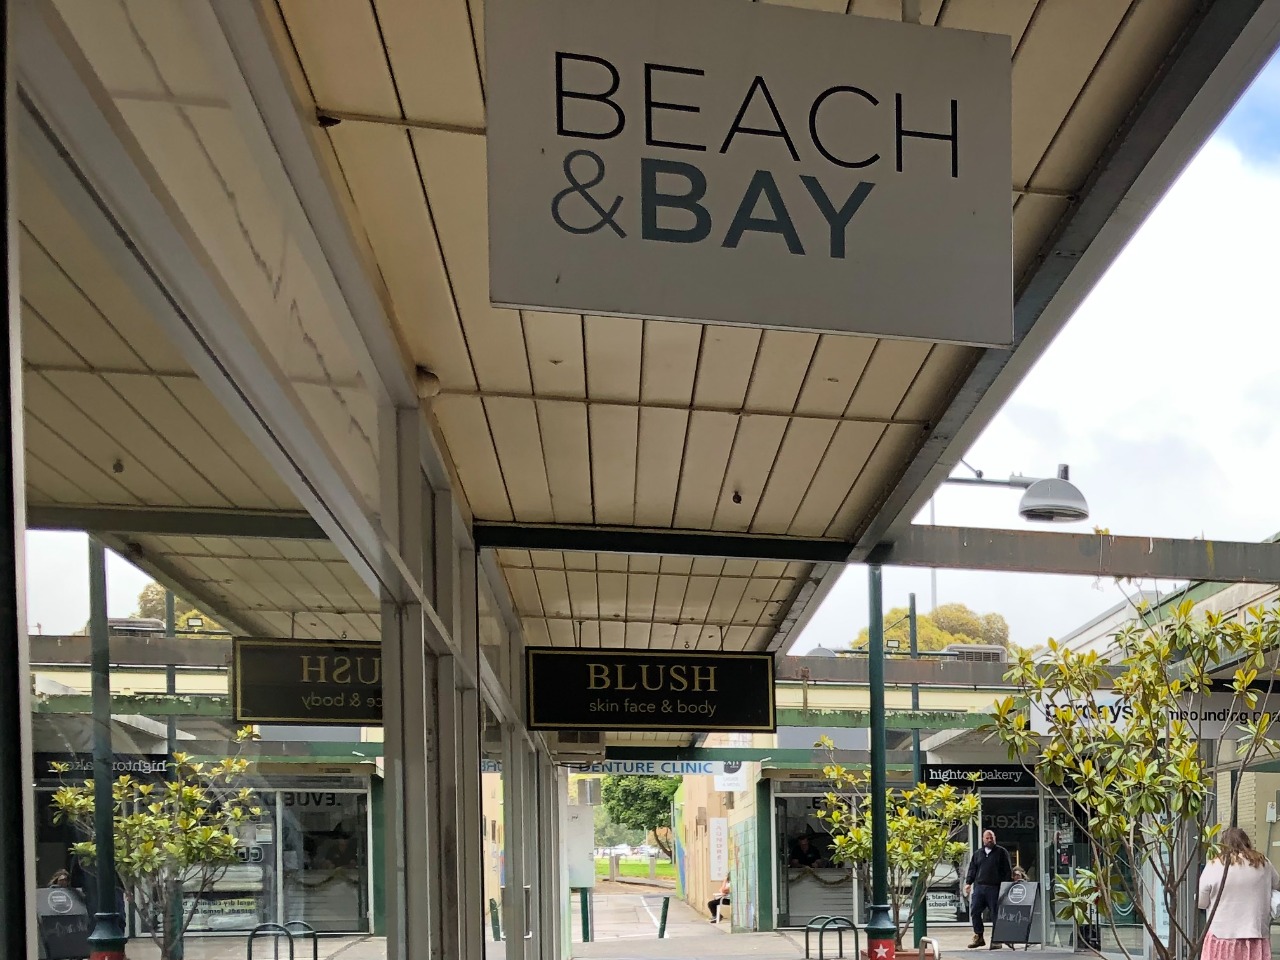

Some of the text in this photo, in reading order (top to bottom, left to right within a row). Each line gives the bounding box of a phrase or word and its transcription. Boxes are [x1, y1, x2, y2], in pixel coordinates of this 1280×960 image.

[555, 51, 958, 178] BEACH
[586, 663, 718, 692] BLUSH
[589, 698, 717, 718] skin face & body
[1168, 708, 1248, 725] mpounding
[578, 761, 655, 774] DENTURE
[661, 761, 713, 774] CLINIC
[979, 769, 1022, 783] bakery
